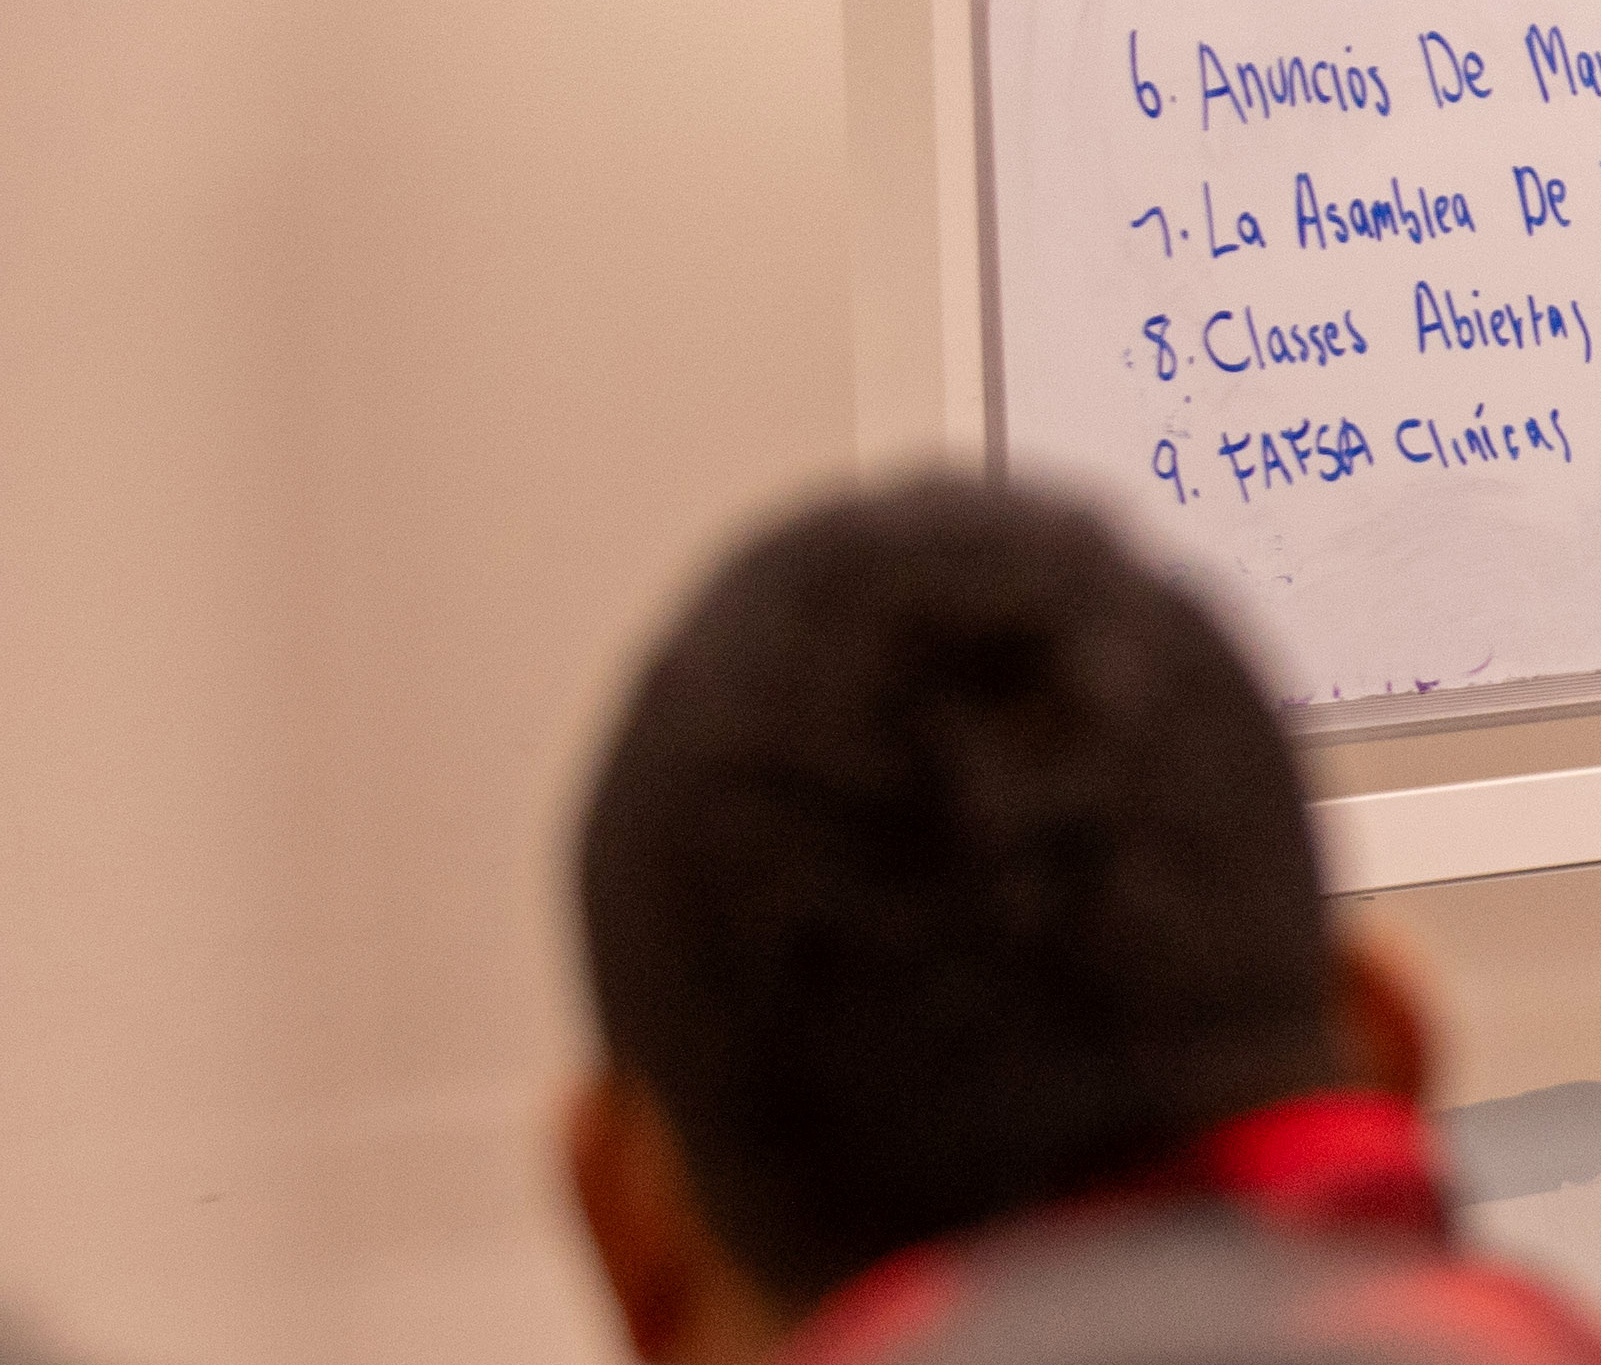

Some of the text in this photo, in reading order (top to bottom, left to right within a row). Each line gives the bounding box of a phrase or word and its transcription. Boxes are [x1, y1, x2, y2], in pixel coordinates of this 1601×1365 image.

[1197, 40, 1392, 132] Anuncios
[1418, 30, 1493, 109] De
[1202, 180, 1267, 260] La
[1294, 170, 1478, 251] Asamblea
[1511, 164, 1572, 236] De
[1202, 304, 1369, 374] Classes
[1217, 417, 1375, 503] FAFSA
